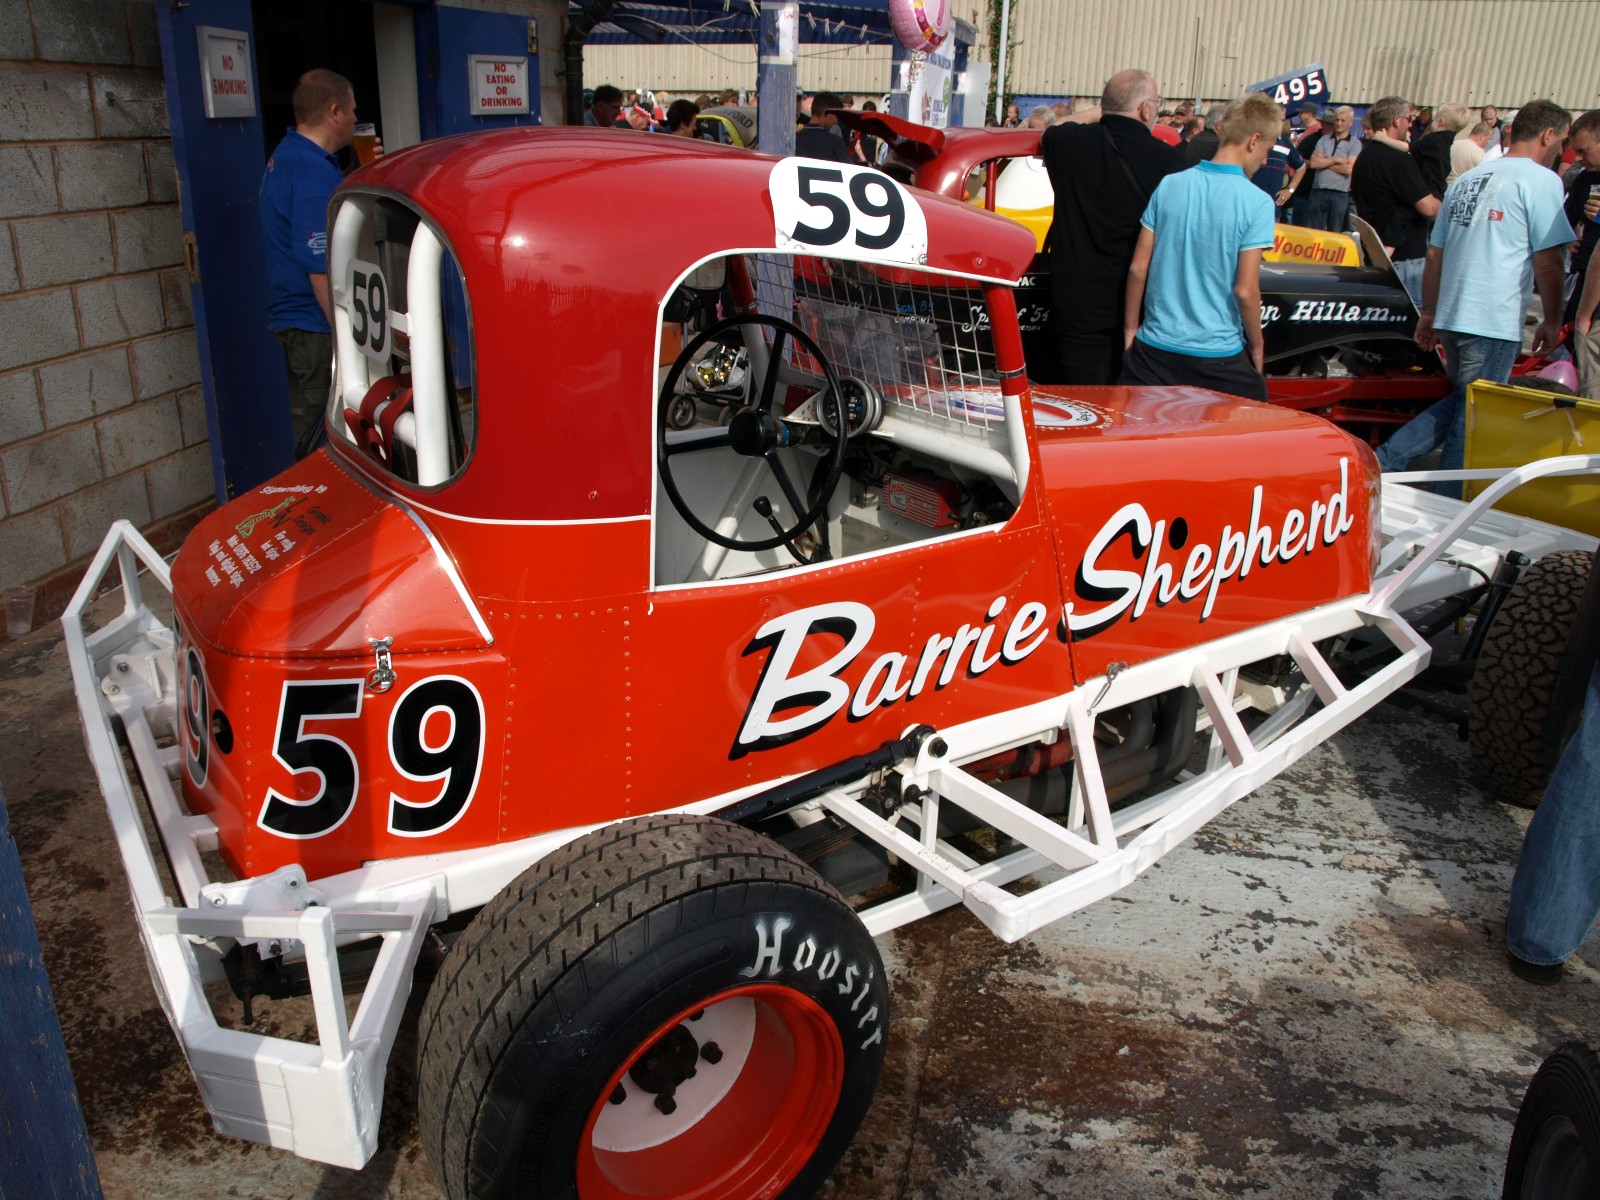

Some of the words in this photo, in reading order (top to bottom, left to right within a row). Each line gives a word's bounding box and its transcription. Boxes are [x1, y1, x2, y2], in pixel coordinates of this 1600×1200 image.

[221, 55, 234, 71] NO
[494, 63, 506, 73] NO
[213, 78, 247, 95] SMOKING
[486, 75, 515, 84] EATING
[496, 87, 508, 96] OR
[1274, 71, 1322, 105] 495
[481, 98, 522, 107] DRINKING
[792, 166, 907, 250] 59
[1273, 236, 1347, 264] Woodhull
[352, 270, 387, 353] 59
[728, 595, 1050, 760] Barrie
[1060, 456, 1354, 637] Shepherd
[256, 674, 486, 841] 59
[738, 916, 882, 1051] Hoosier
